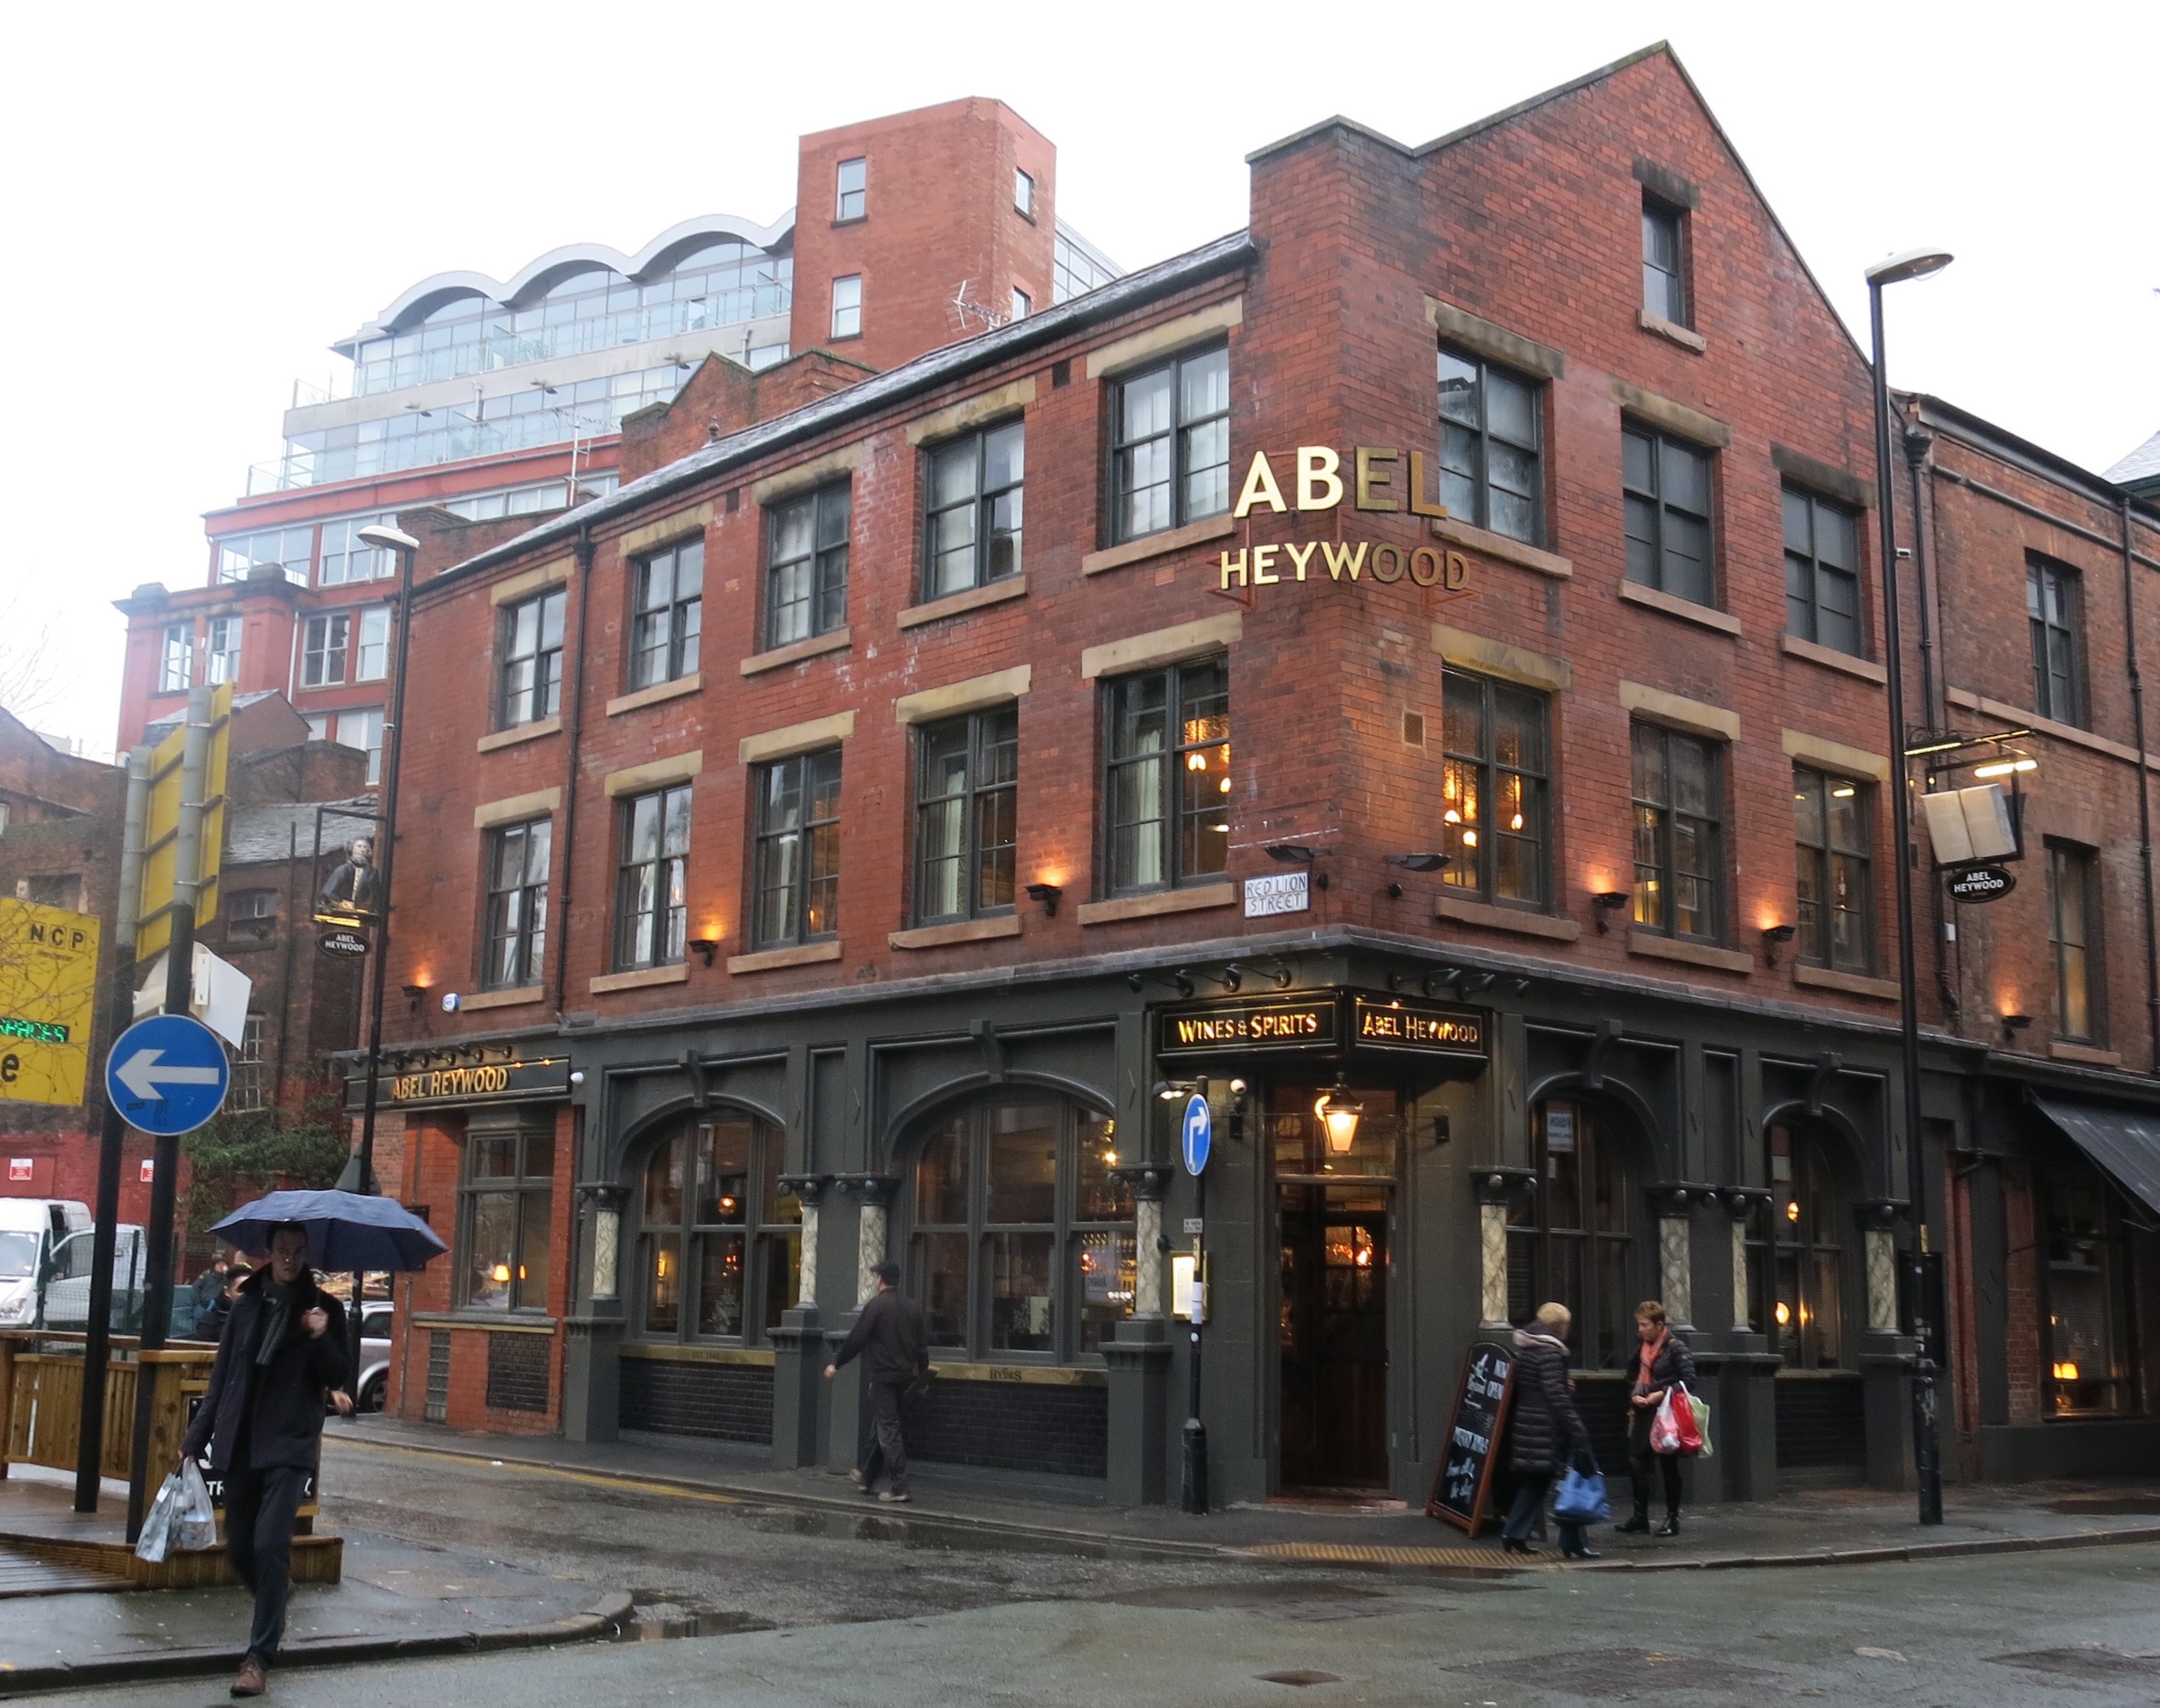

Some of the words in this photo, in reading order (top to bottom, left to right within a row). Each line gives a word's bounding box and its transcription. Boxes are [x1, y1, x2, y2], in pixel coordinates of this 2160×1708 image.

[1233, 446, 1448, 521] ABEL
[1220, 542, 1470, 591] HEYWOOD
[1247, 881, 1271, 897] RED
[1276, 875, 1306, 893] LION
[1953, 879, 2004, 893] HEYWOOD
[1966, 872, 1991, 882] ABEL
[1252, 892, 1300, 912] STREET
[30, 923, 83, 950] NCP
[325, 941, 365, 952] HEYWOOD
[335, 934, 355, 943] ABEL
[1178, 1019, 1234, 1042] WINES
[1237, 1020, 1247, 1036] &
[1250, 1013, 1317, 1039] SPIRITS
[1362, 1012, 1401, 1036] ABEL
[1406, 1016, 1478, 1042] HEYWOOD
[393, 1076, 427, 1100] ABEL
[430, 1068, 509, 1096] HEYWOOD
